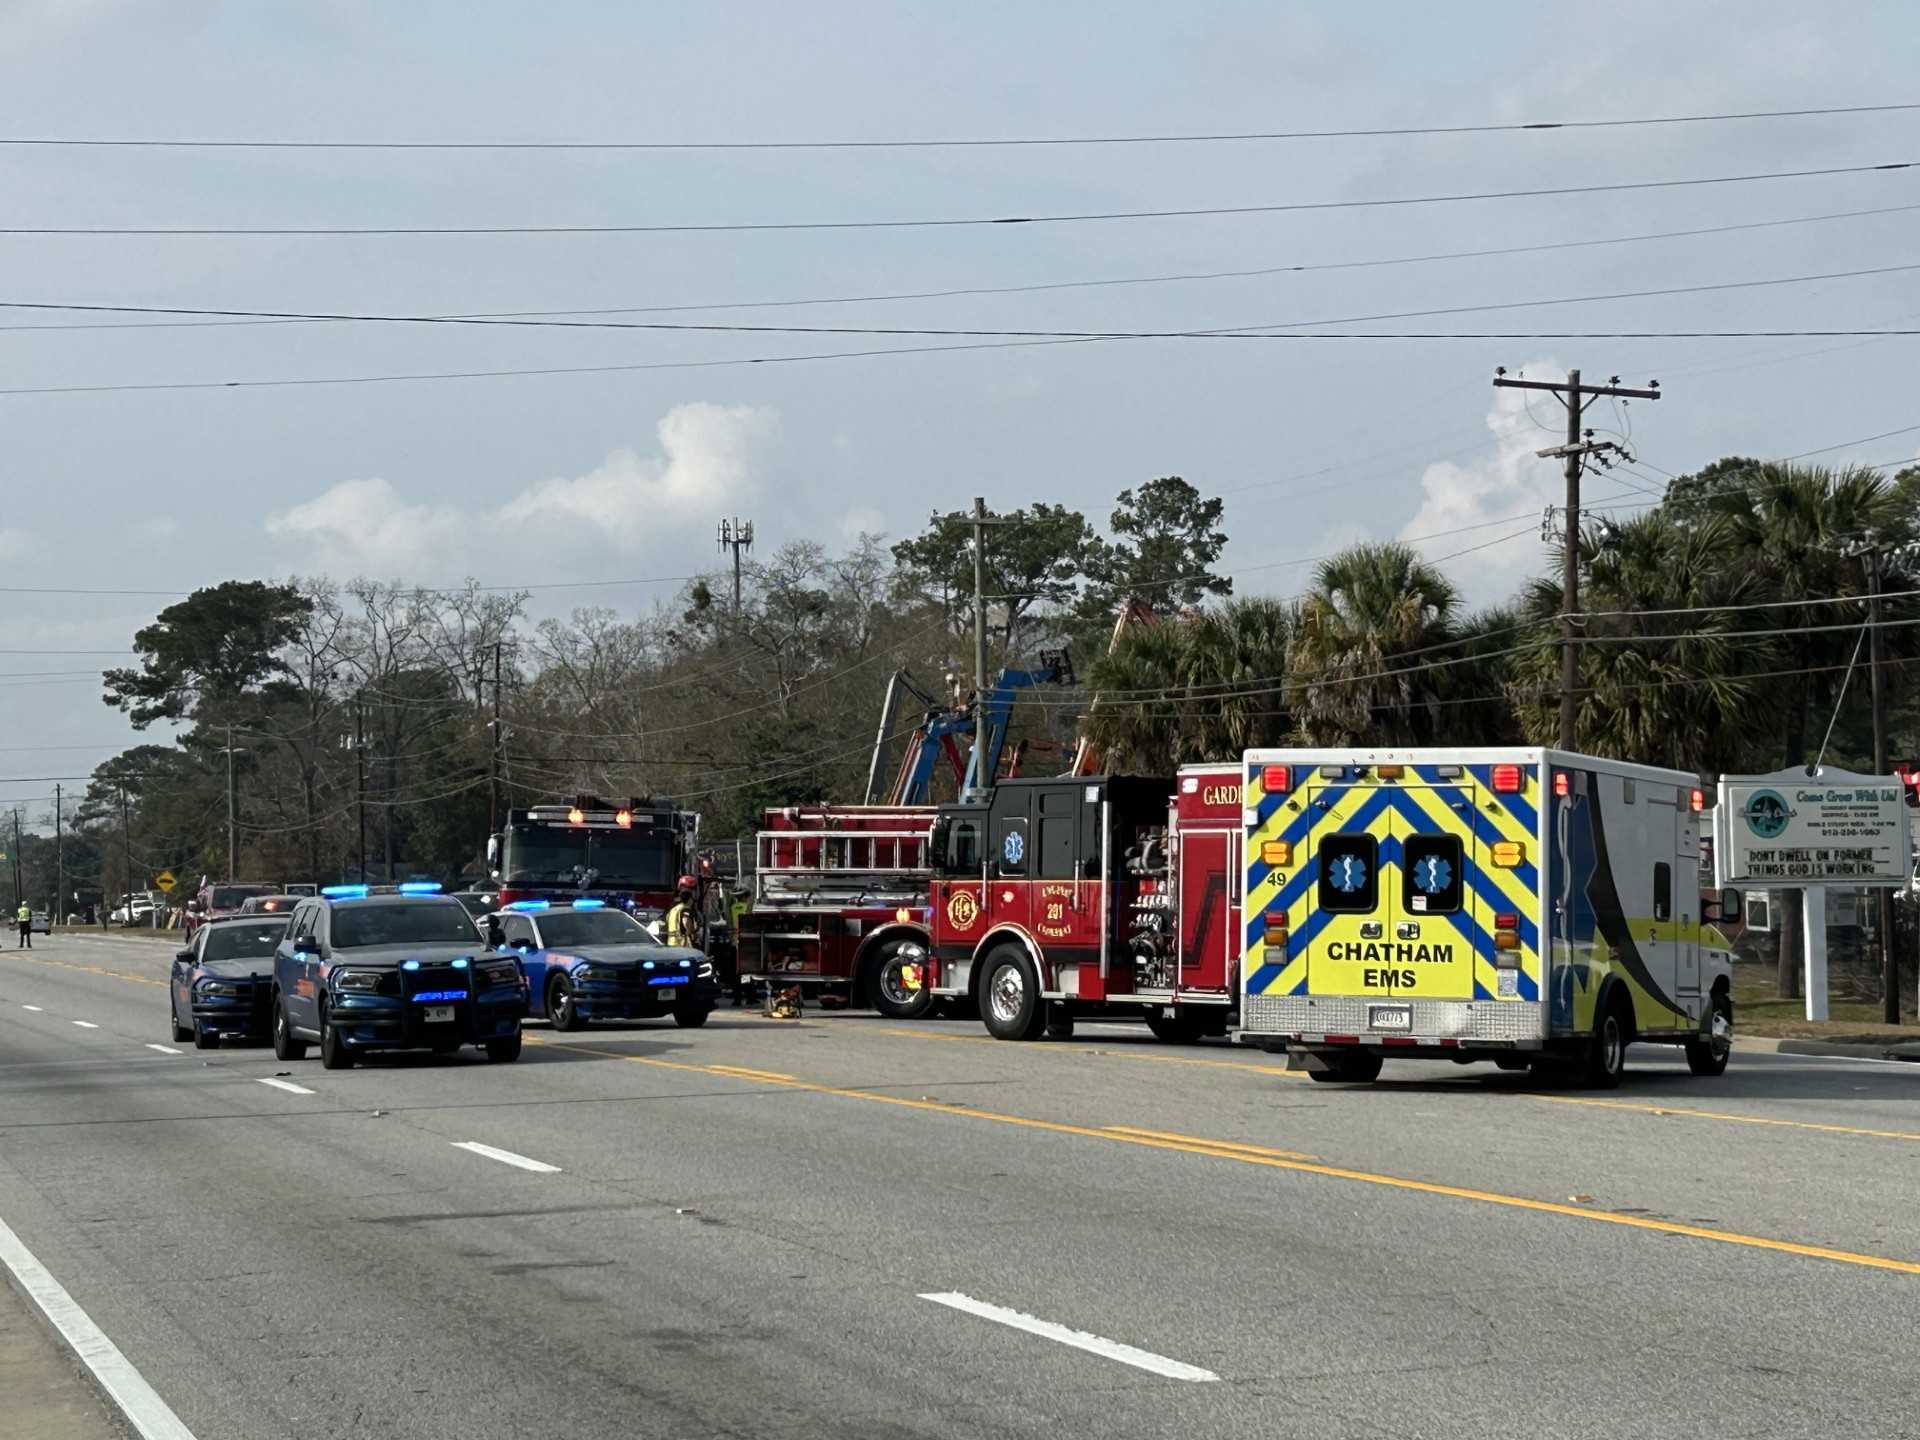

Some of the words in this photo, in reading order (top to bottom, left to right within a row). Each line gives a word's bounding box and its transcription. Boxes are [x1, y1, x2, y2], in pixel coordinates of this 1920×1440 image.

[1779, 849, 1812, 862] DWELL
[1816, 850, 1830, 861] ON
[1834, 848, 1873, 861] FORMER
[1748, 863, 1785, 875] THINGS
[1788, 863, 1809, 875] GOD
[1812, 863, 1823, 875] IS
[1825, 863, 1875, 875] WORKING
[1267, 872, 1286, 886] 49
[1327, 942, 1453, 962] CHATHAM
[1363, 968, 1416, 988] EMS
